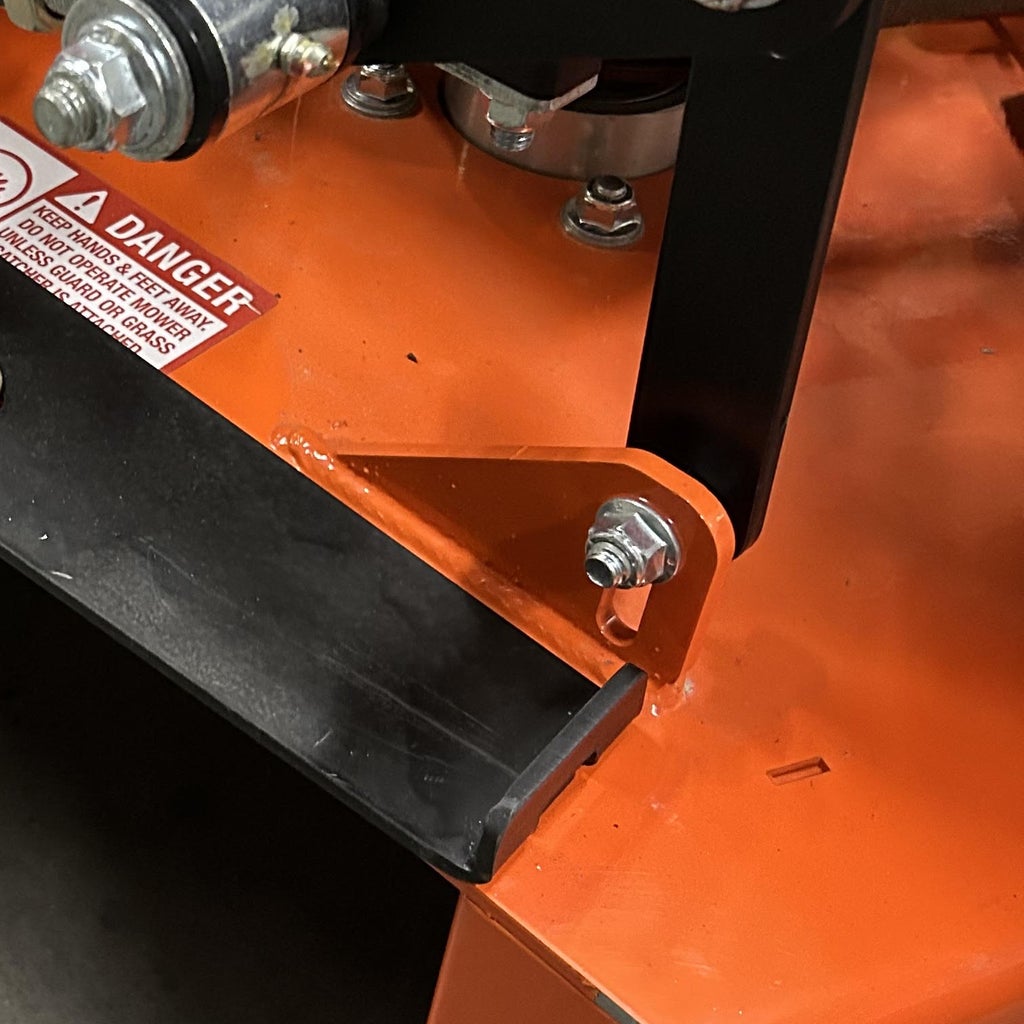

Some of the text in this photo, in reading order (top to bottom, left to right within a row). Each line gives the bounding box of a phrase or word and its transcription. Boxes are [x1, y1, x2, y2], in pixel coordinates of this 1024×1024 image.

[18, 218, 192, 341] DO NOT OPERATE MOWER
[33, 205, 214, 331] KEEP HANDS & FEET AWAY.
[49, 265, 102, 302] GUARD
[98, 299, 125, 319] OR
[121, 316, 176, 354] GRASS
[105, 214, 253, 316] DANGER
